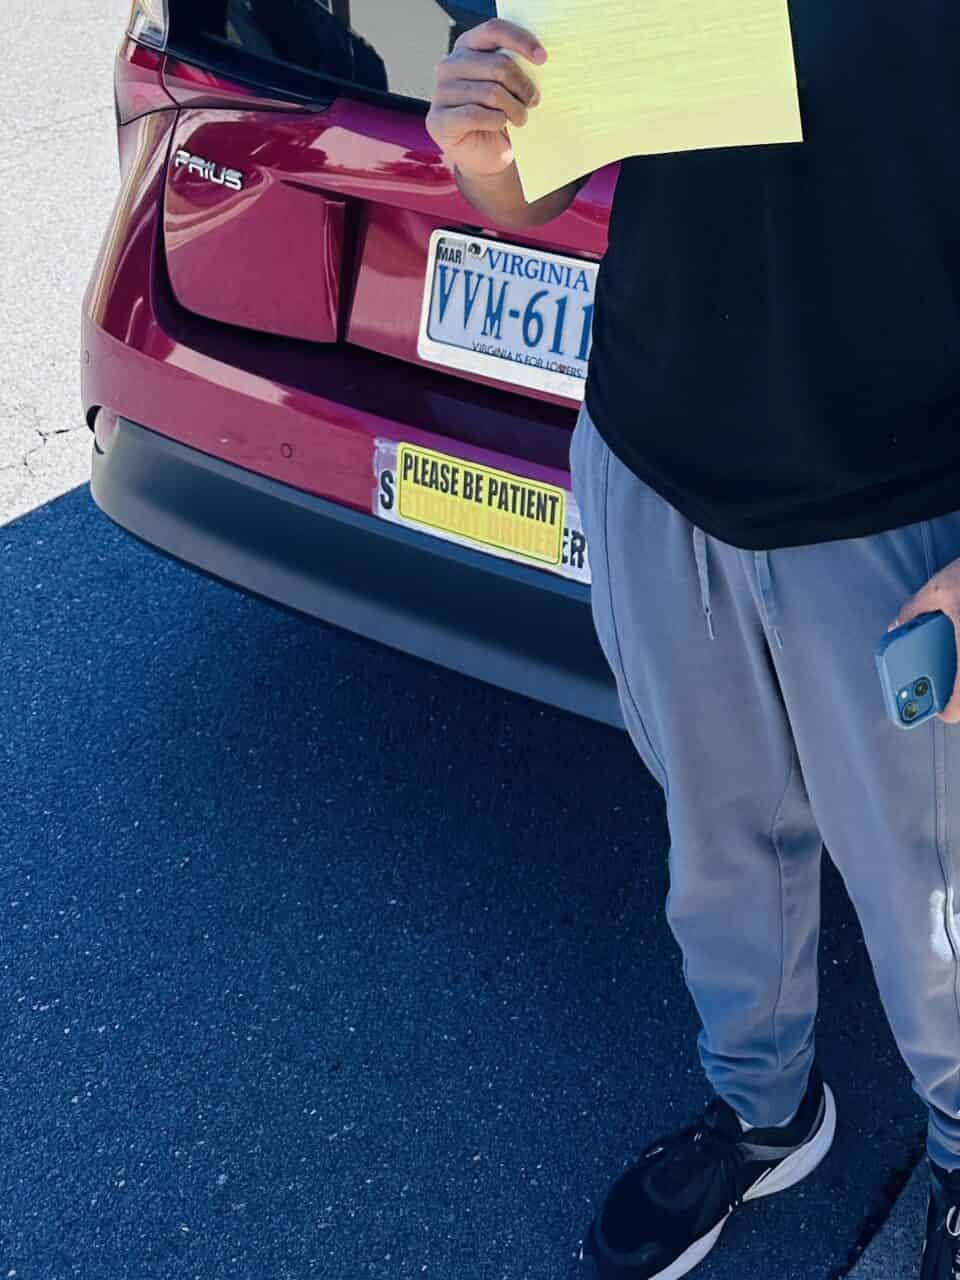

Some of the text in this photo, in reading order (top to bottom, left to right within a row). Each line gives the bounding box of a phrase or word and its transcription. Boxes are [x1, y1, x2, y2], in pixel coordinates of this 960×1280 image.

[175, 150, 243, 191] PRIUS
[438, 246, 462, 265] MAR
[485, 247, 590, 292] VIRGINIA
[471, 341, 513, 360] VIRGINIA
[514, 352, 524, 363] IS
[524, 354, 544, 369] FOR
[402, 452, 559, 526] PLEASE BE PATIENT
